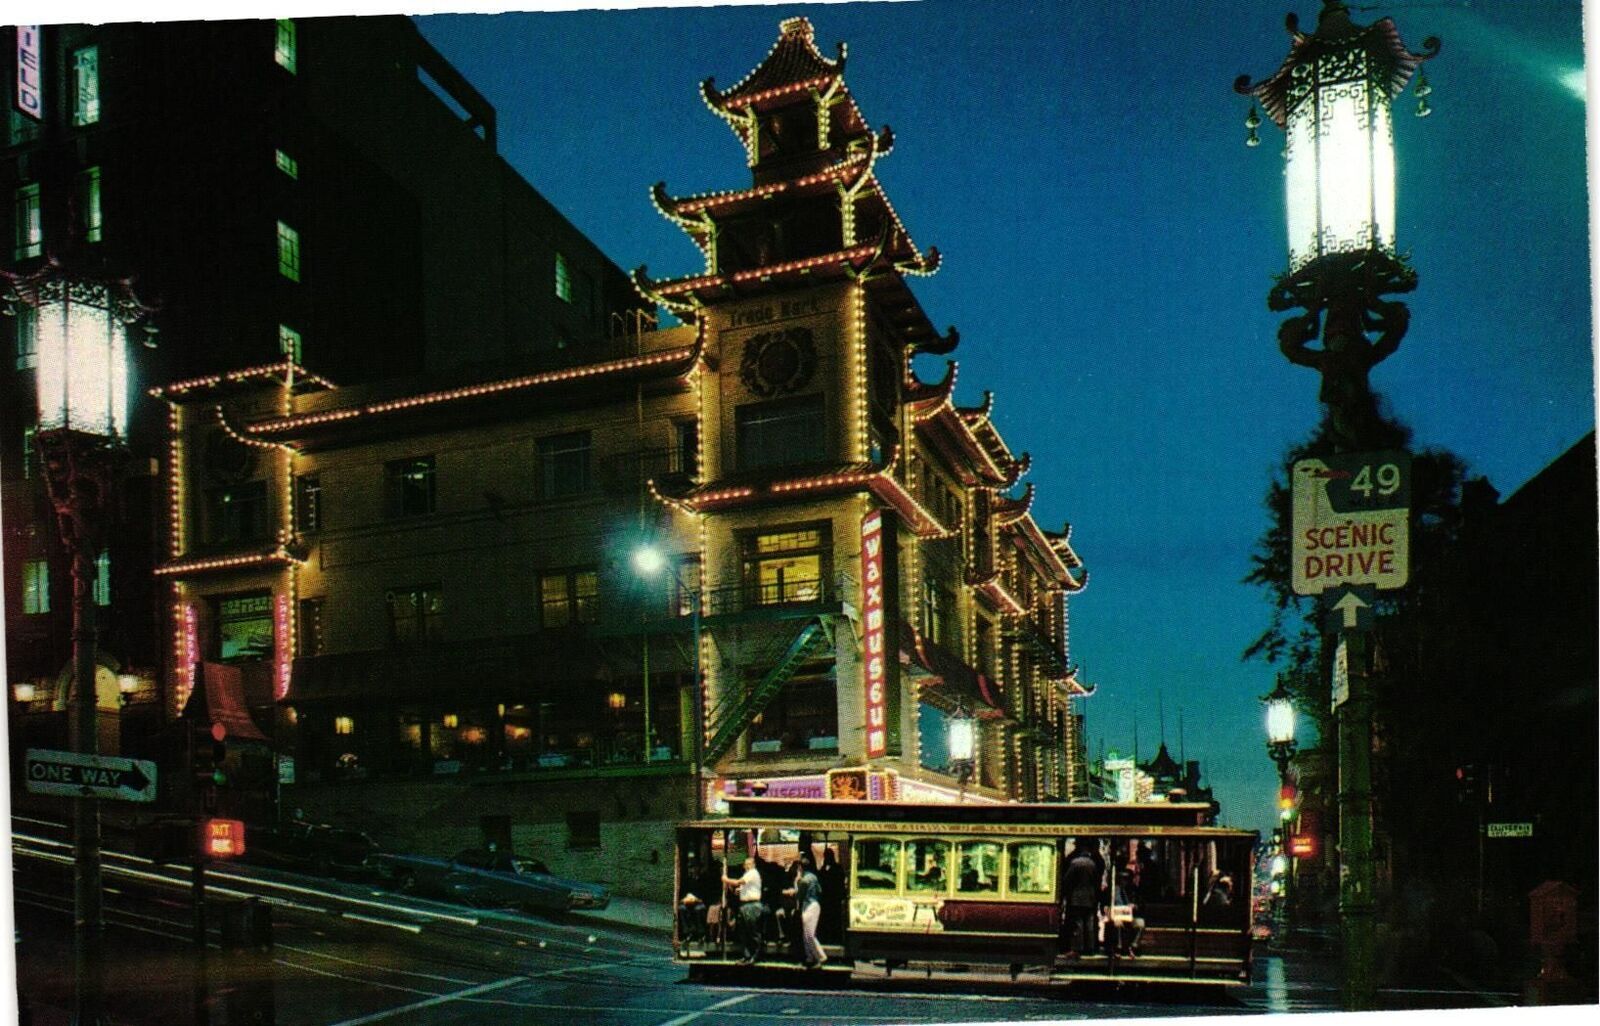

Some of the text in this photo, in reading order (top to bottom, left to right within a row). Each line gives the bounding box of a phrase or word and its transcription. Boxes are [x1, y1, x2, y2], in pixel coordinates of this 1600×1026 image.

[19, 25, 38, 110] IELD
[1350, 463, 1400, 497] 49
[1305, 522, 1395, 551] SCENIC
[1305, 550, 1395, 580] DRIVE
[31, 762, 121, 787] ONE WAY
